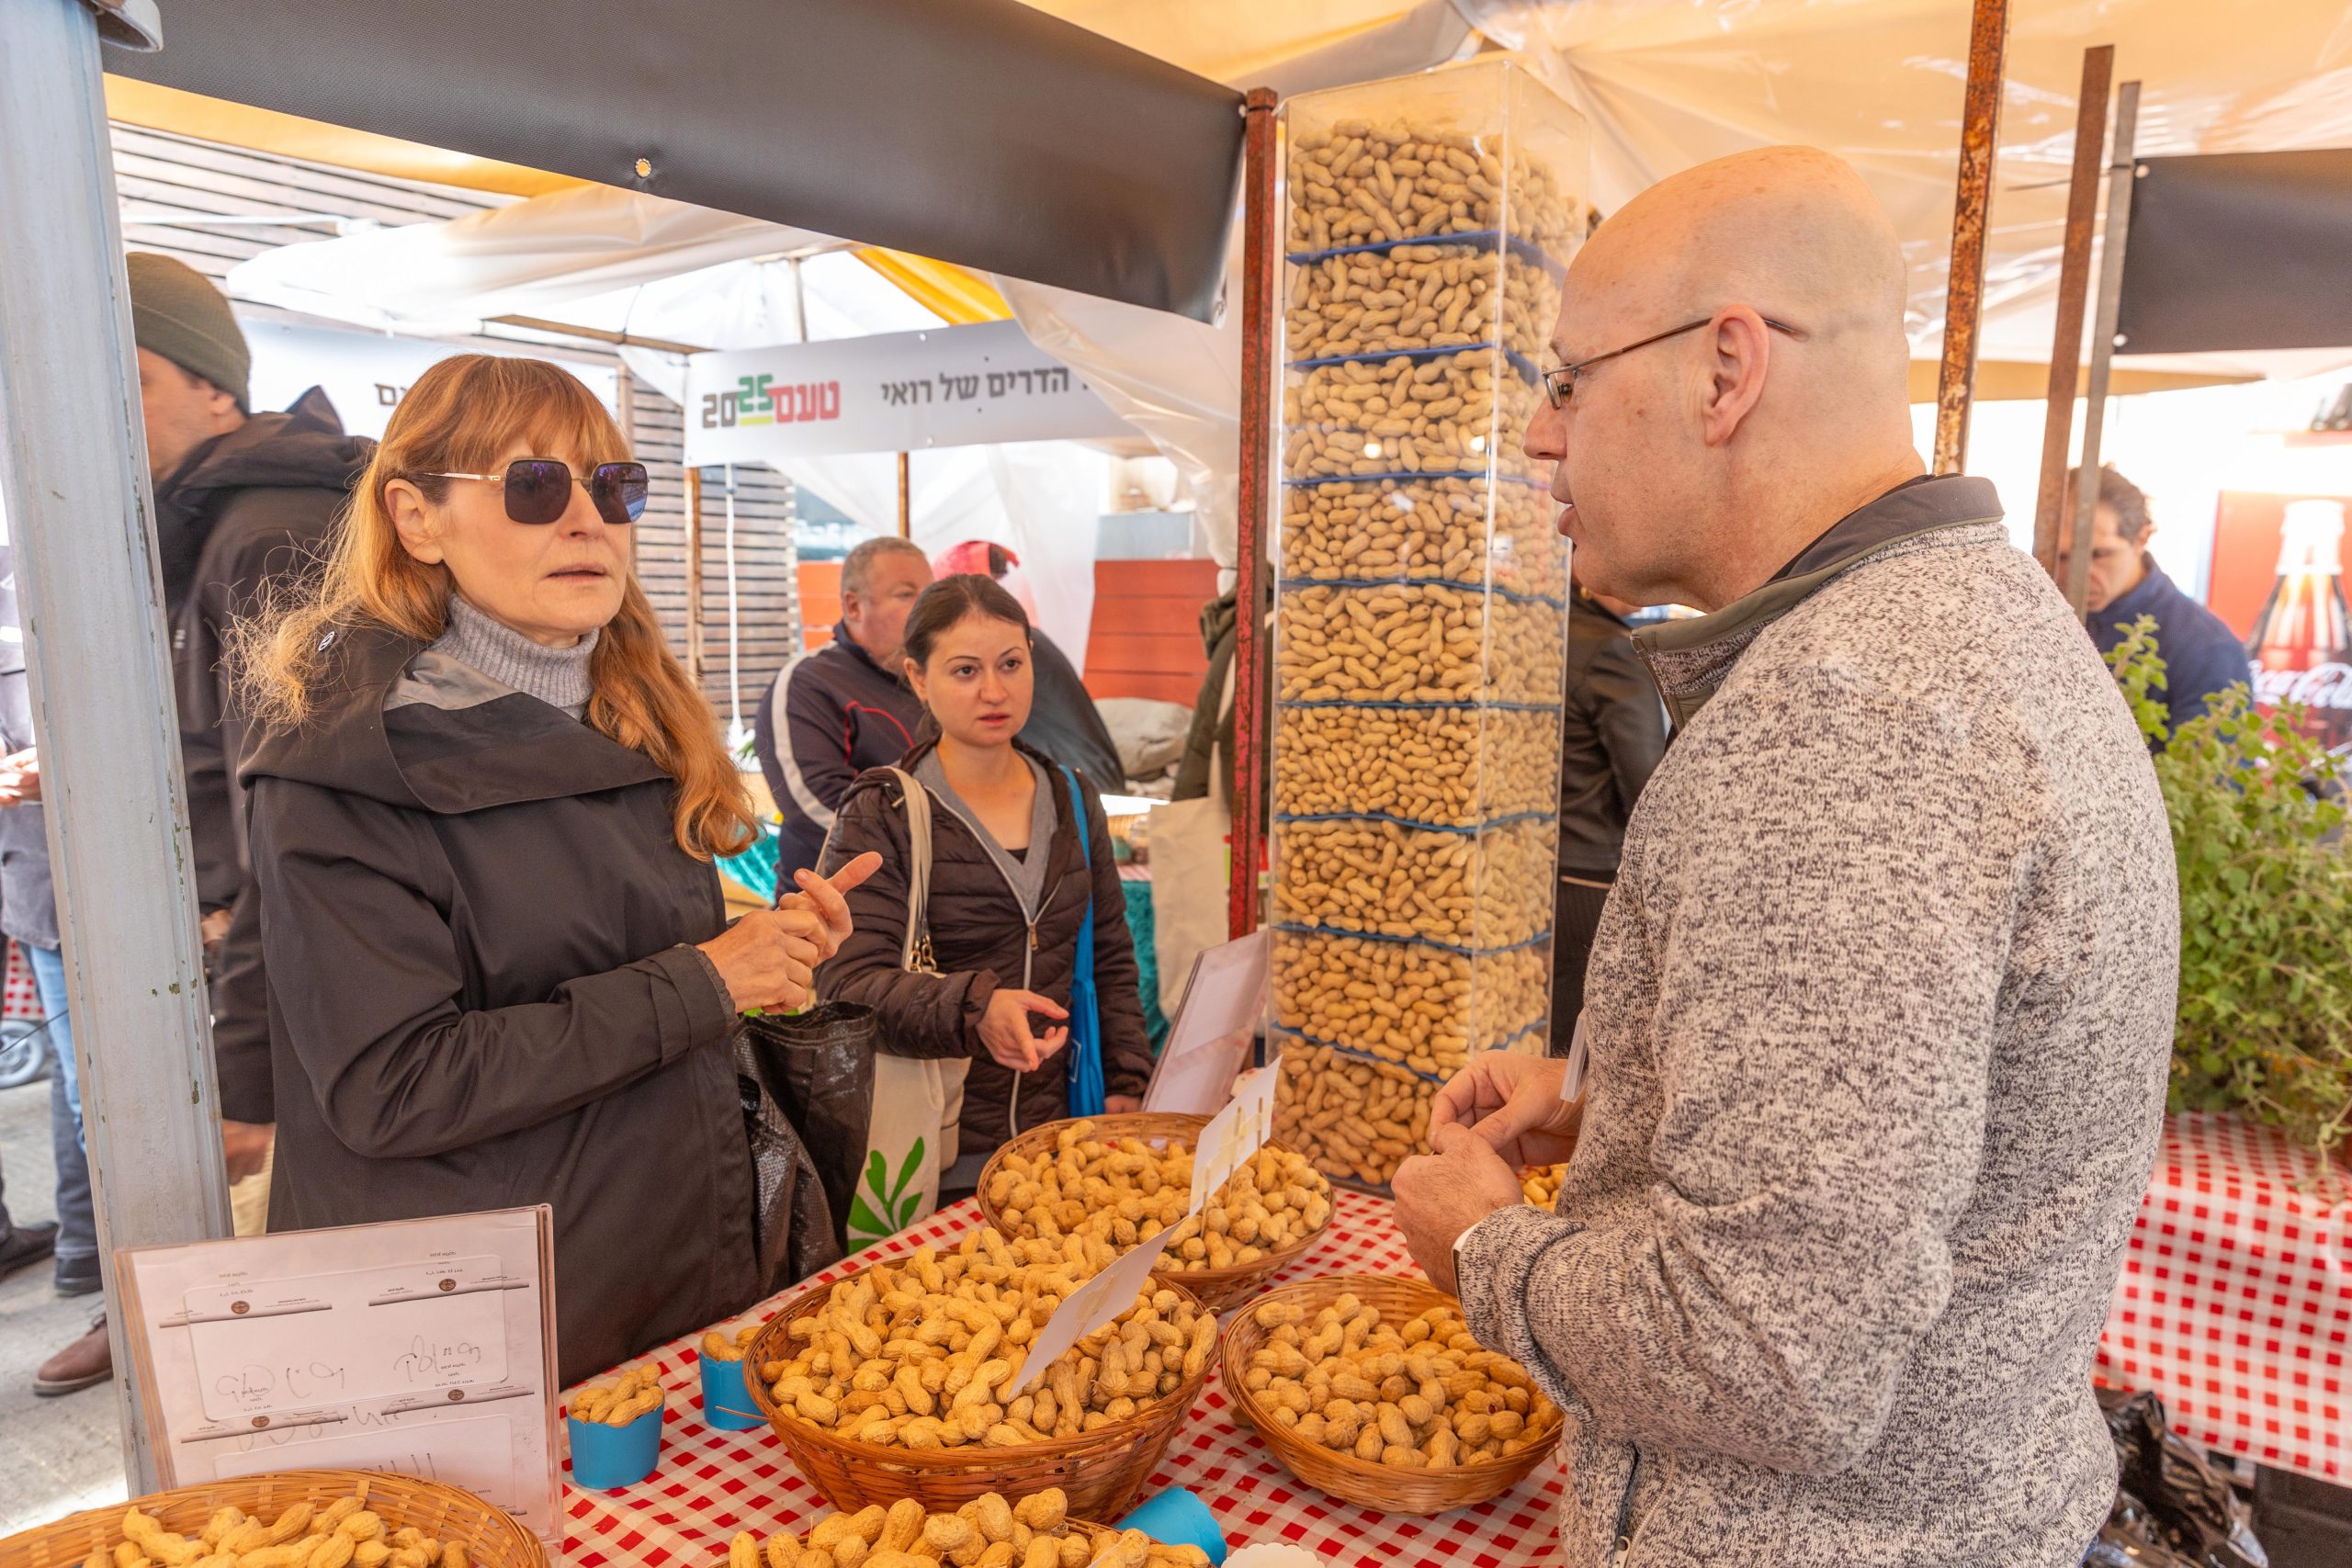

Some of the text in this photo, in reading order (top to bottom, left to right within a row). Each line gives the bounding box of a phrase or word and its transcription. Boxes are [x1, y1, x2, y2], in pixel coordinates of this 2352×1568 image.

[766, 381, 840, 423] טעם
[880, 367, 1069, 406] הדרים של רואי
